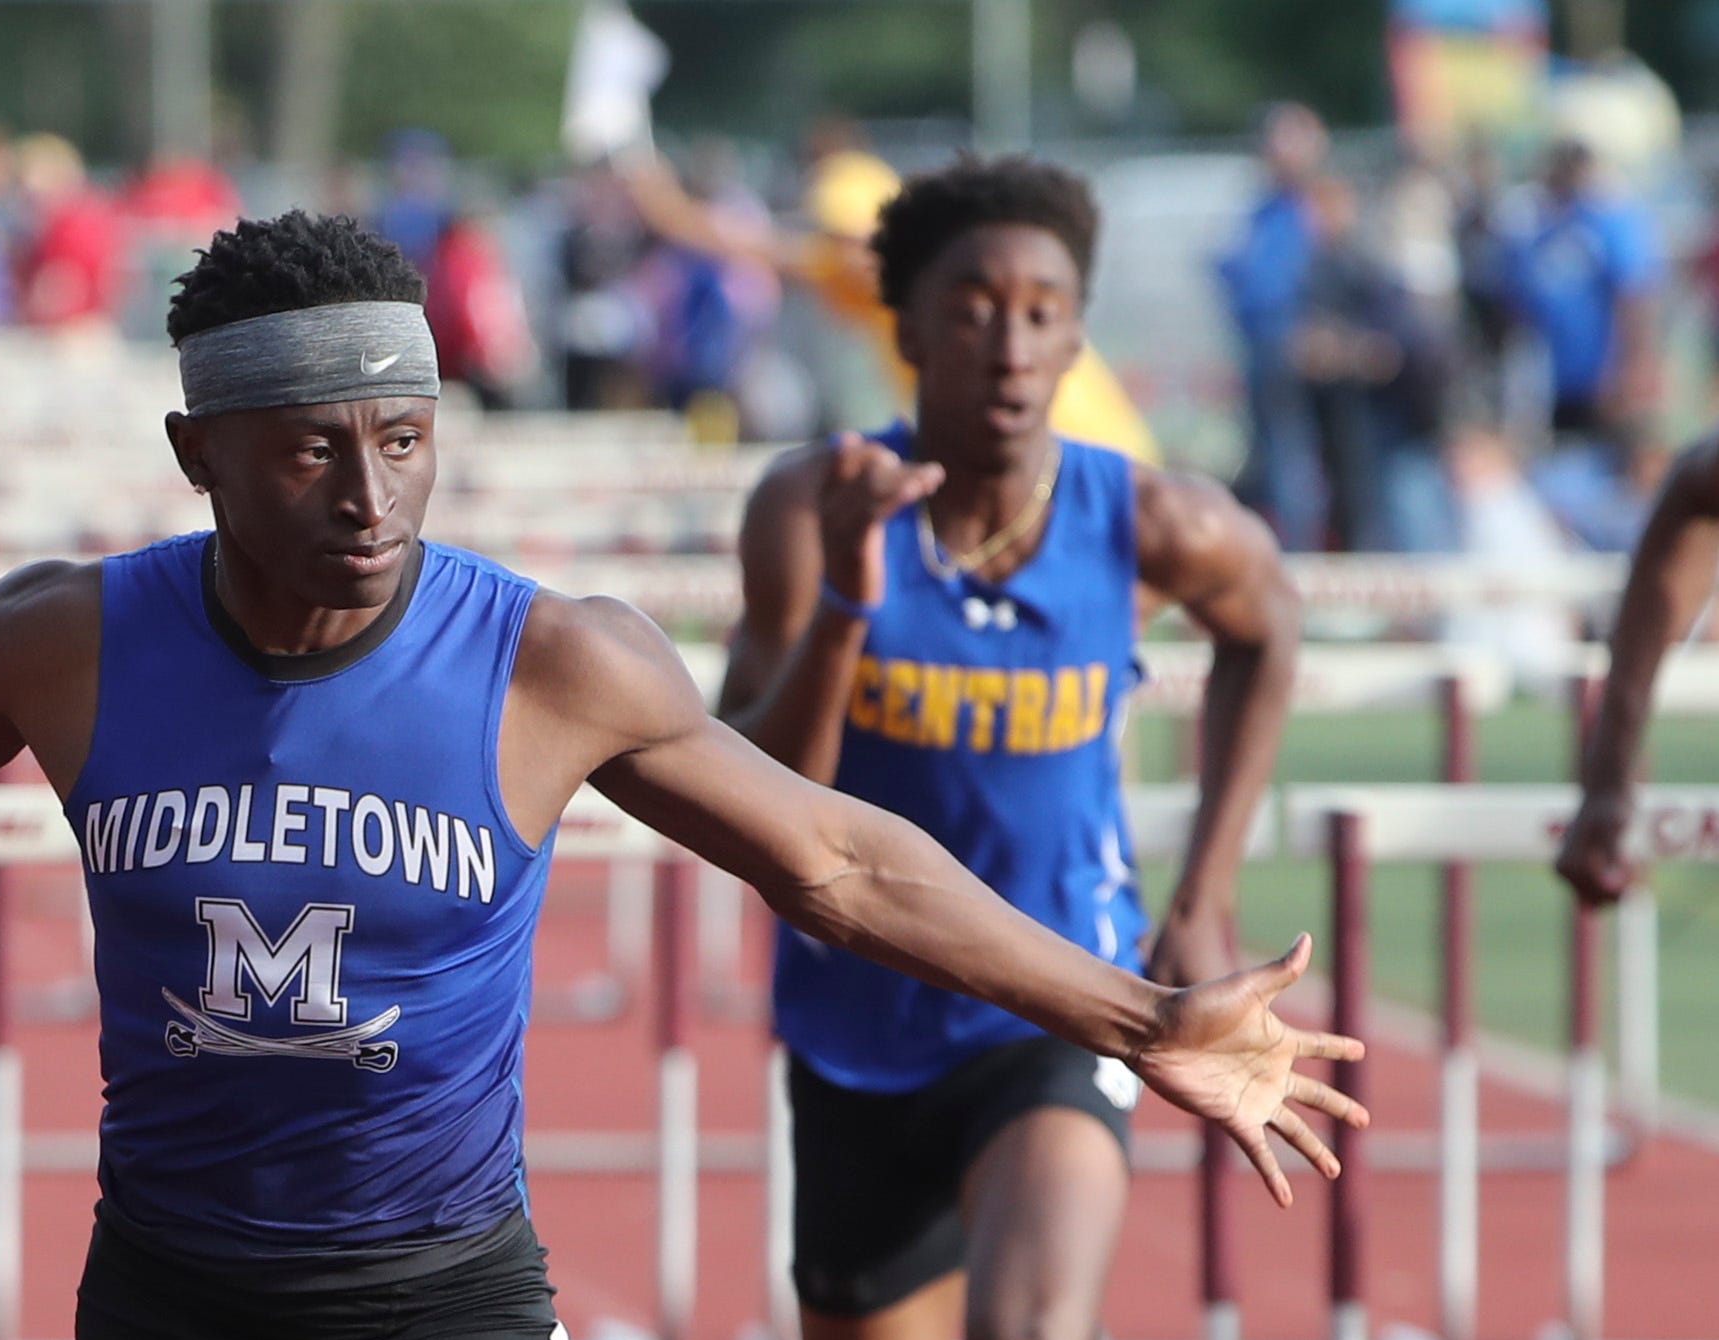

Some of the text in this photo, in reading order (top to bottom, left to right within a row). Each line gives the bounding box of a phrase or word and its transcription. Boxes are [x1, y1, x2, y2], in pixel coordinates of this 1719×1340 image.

[848, 655, 1109, 756] CENTRAL
[85, 783, 497, 904] MIDDLETOWN
[195, 896, 356, 1027] M
